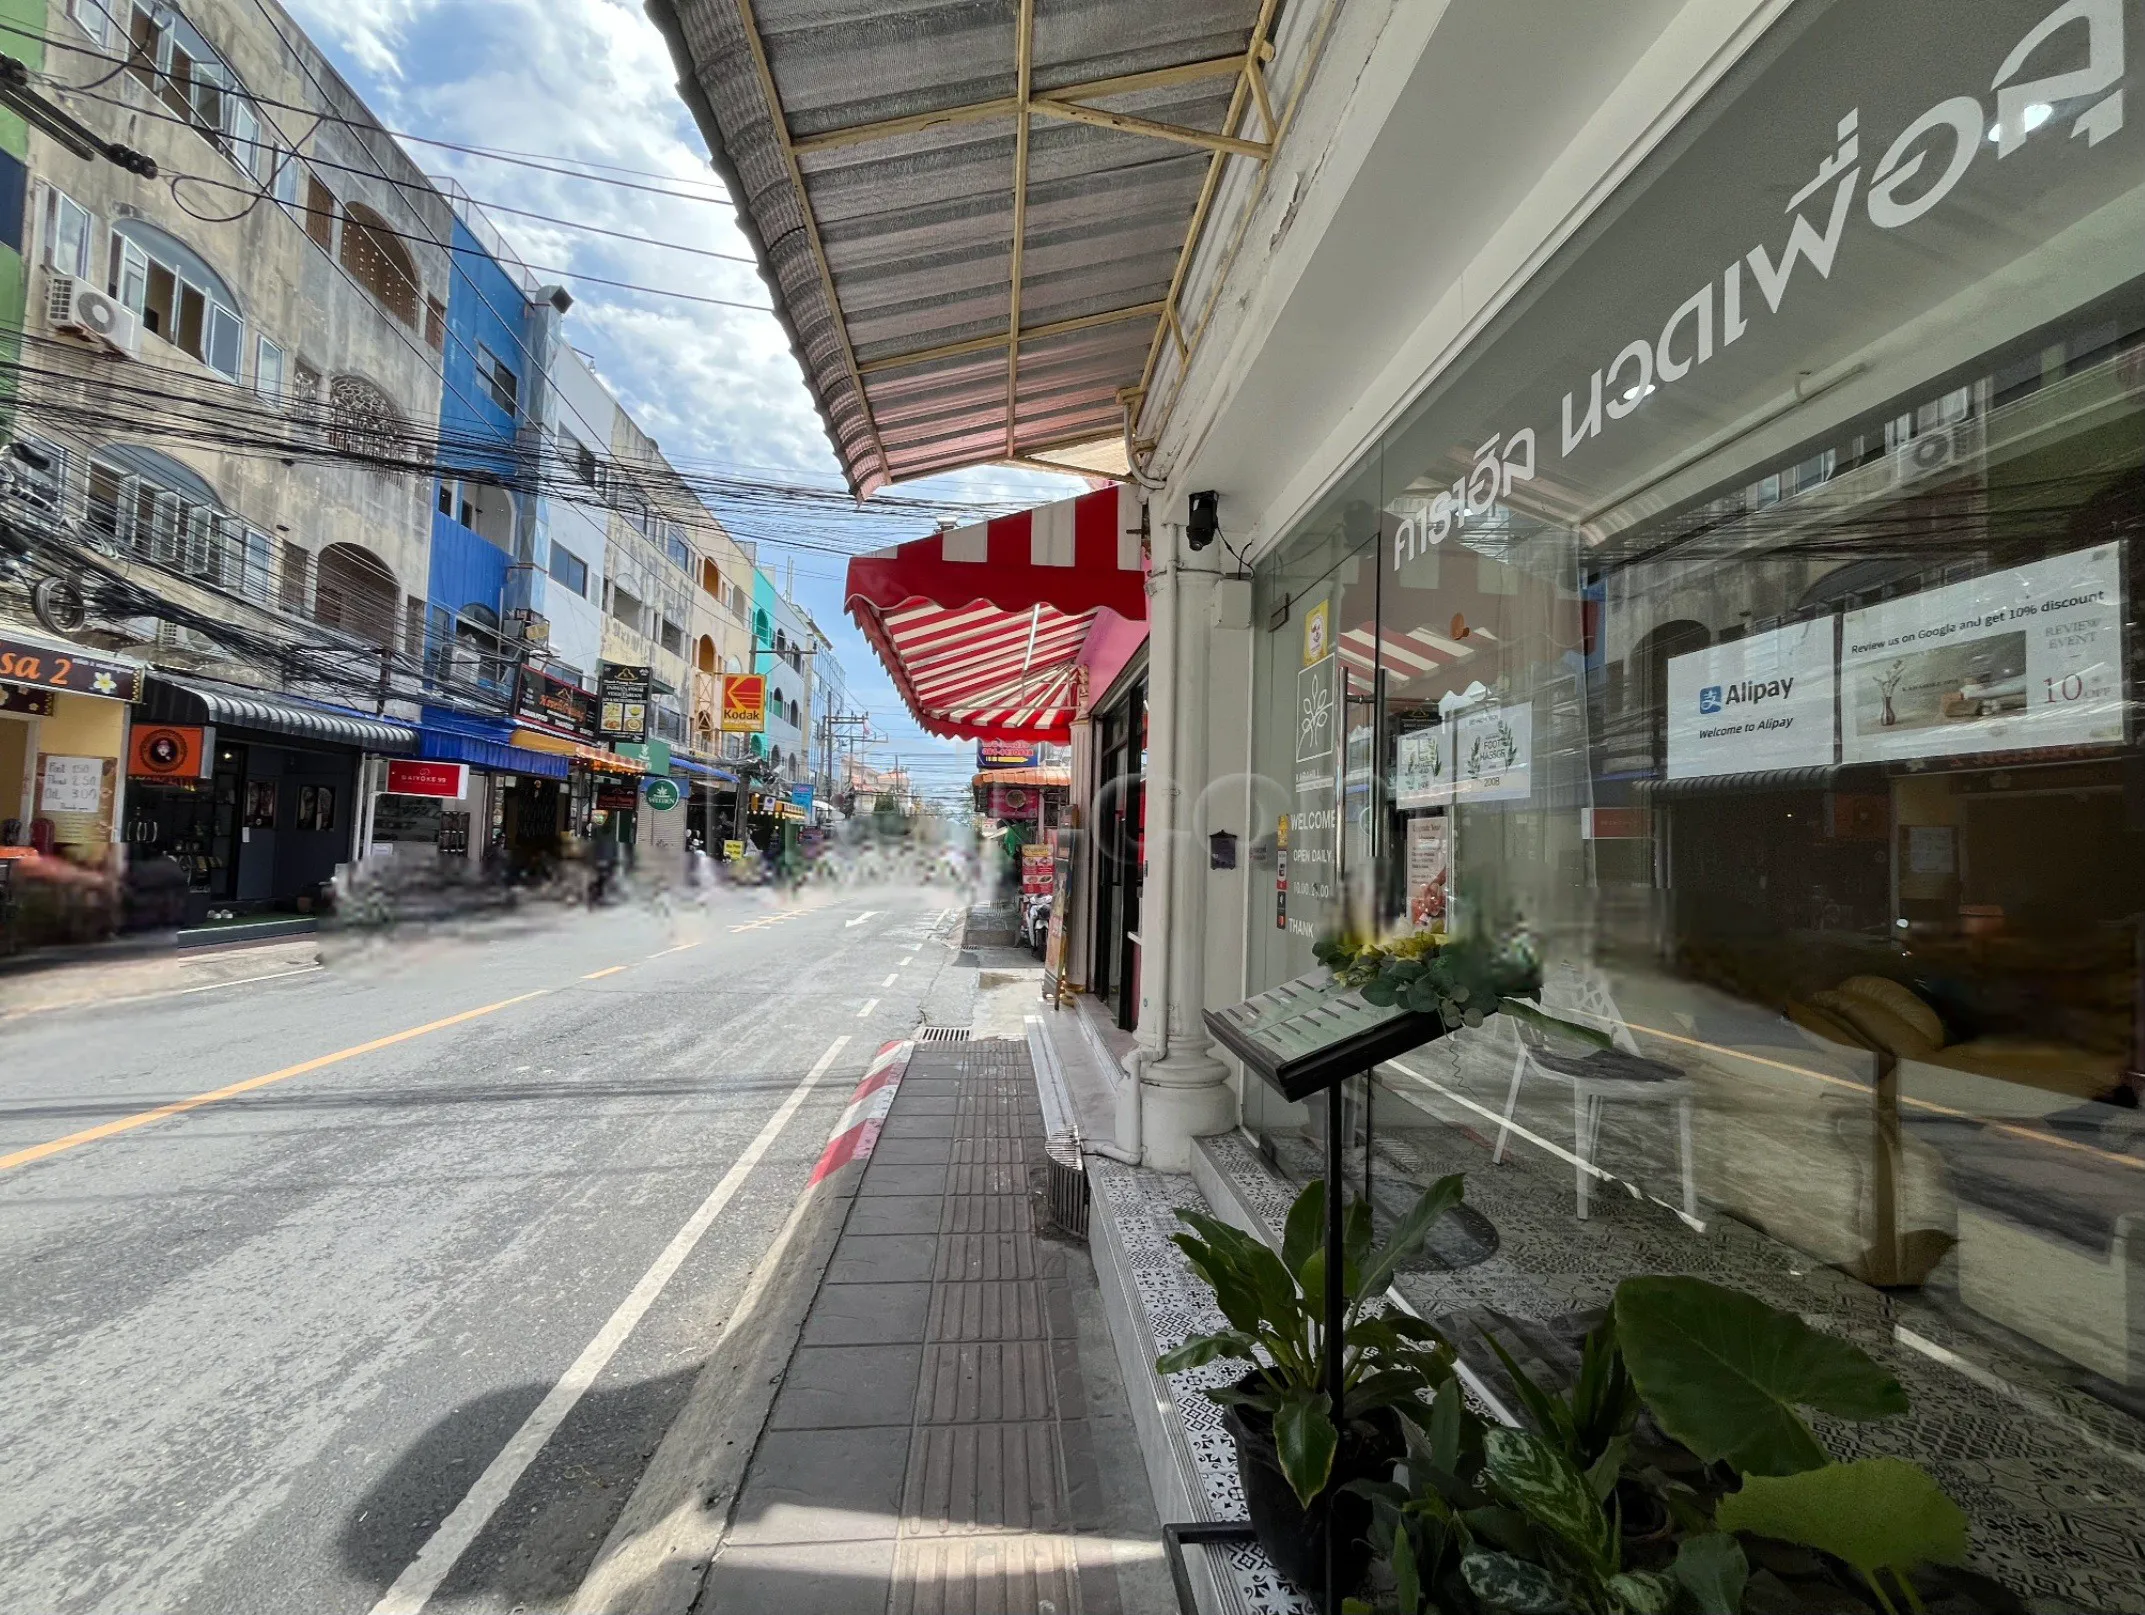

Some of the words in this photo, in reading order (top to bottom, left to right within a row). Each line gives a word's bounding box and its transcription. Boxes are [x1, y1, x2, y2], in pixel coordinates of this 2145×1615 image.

[1851, 640, 1886, 654] Review
[1888, 637, 1900, 646] us
[1901, 634, 1916, 643] on
[1918, 623, 1956, 639] Google
[1959, 616, 1982, 631] and
[1984, 613, 2006, 627] get
[2009, 604, 2038, 620] 10%
[2040, 590, 2105, 613] discount
[2045, 619, 2100, 637] REVIEW
[2048, 631, 2097, 650] EVENT
[49, 658, 71, 685] 2
[1725, 677, 1795, 705] Alipay
[2043, 673, 2083, 704] 10
[724, 709, 761, 720] Kodak
[1699, 725, 1743, 740] Welcome
[1744, 722, 1756, 733] to
[1757, 717, 1794, 732] Alipay
[1290, 809, 1336, 831] WELCOME
[1293, 849, 1310, 863] OPEN
[1311, 849, 1333, 863] DAILY
[1288, 917, 1314, 939] THANK
